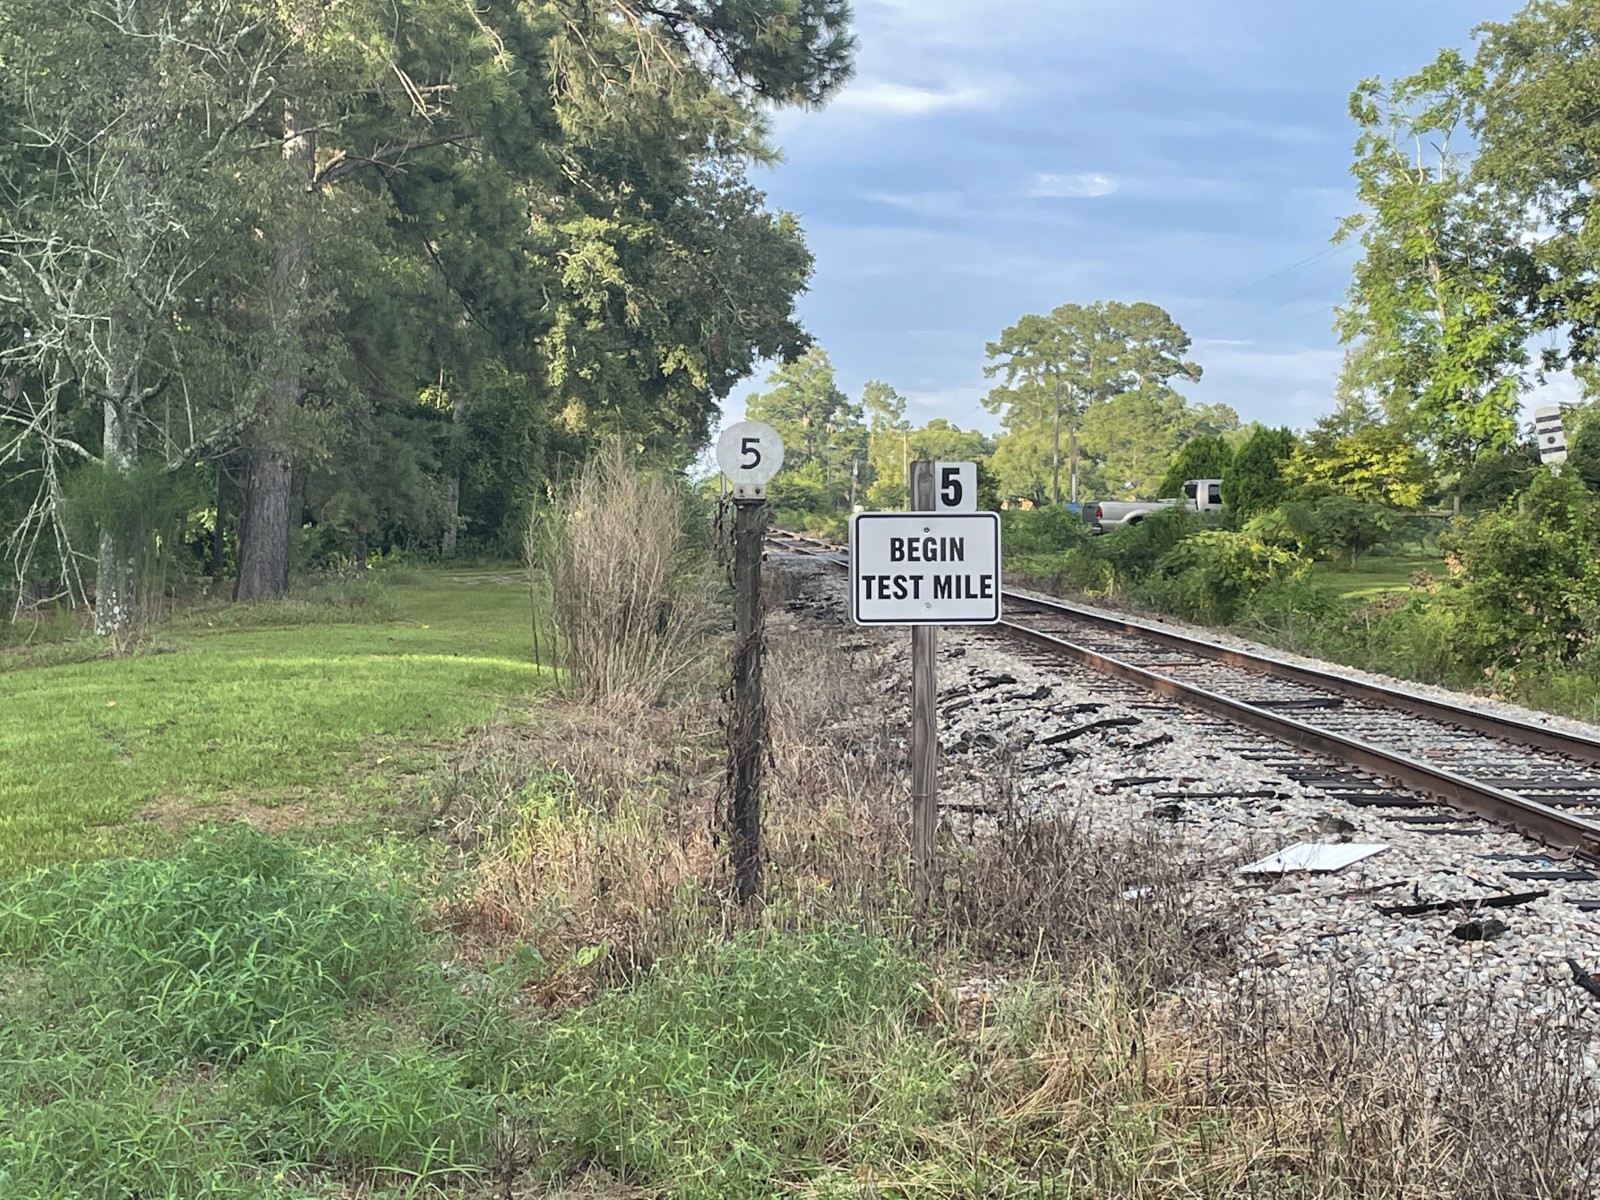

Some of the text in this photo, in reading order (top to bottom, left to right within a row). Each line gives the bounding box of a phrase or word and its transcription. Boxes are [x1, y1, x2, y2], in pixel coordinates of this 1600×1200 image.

[740, 437, 761, 470] 5
[941, 467, 963, 506] 5
[890, 537, 964, 562] BEGIN
[861, 574, 993, 600] TEST MILE
